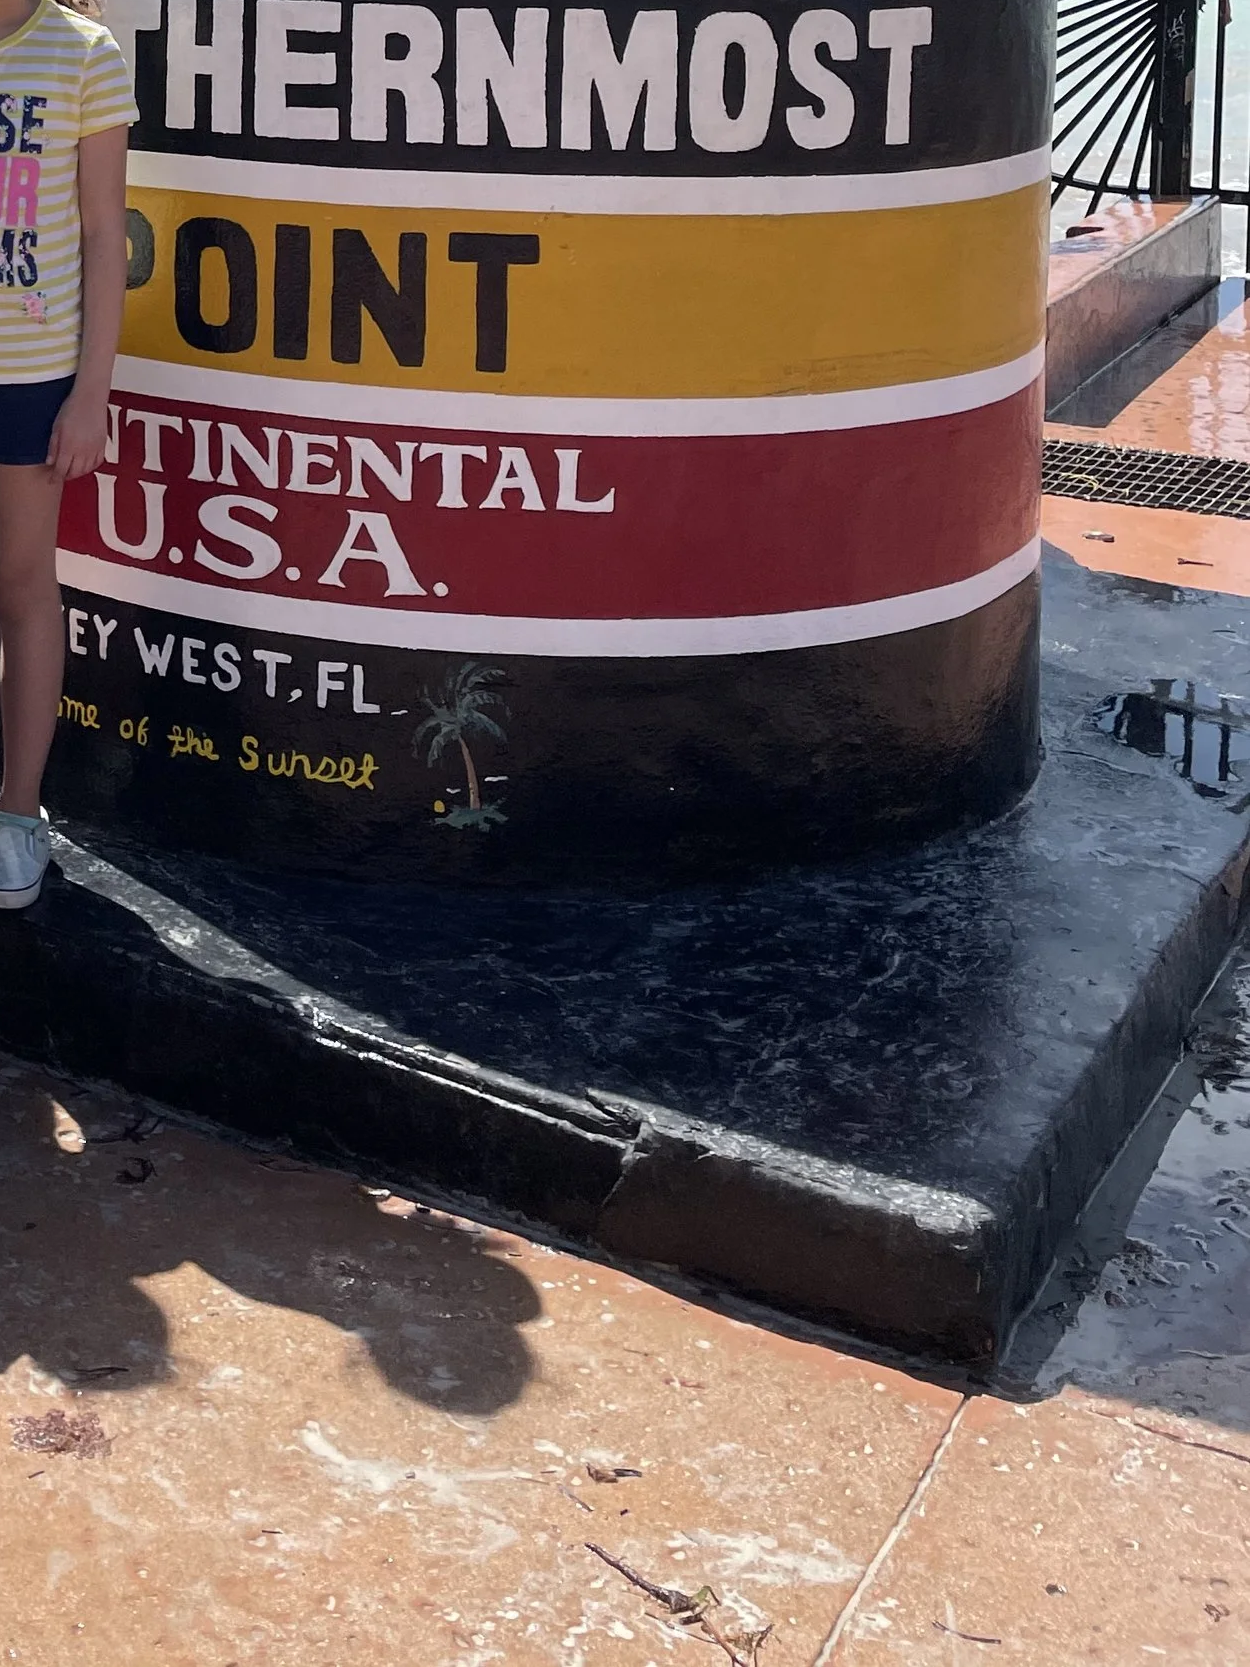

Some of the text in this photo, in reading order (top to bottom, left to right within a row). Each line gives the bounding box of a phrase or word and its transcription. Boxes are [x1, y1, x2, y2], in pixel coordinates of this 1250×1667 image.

[93, 471, 450, 598] U.S.A.
[61, 605, 119, 661] EY
[133, 626, 303, 703] WEST,
[57, 695, 380, 790] me of the Sunset
